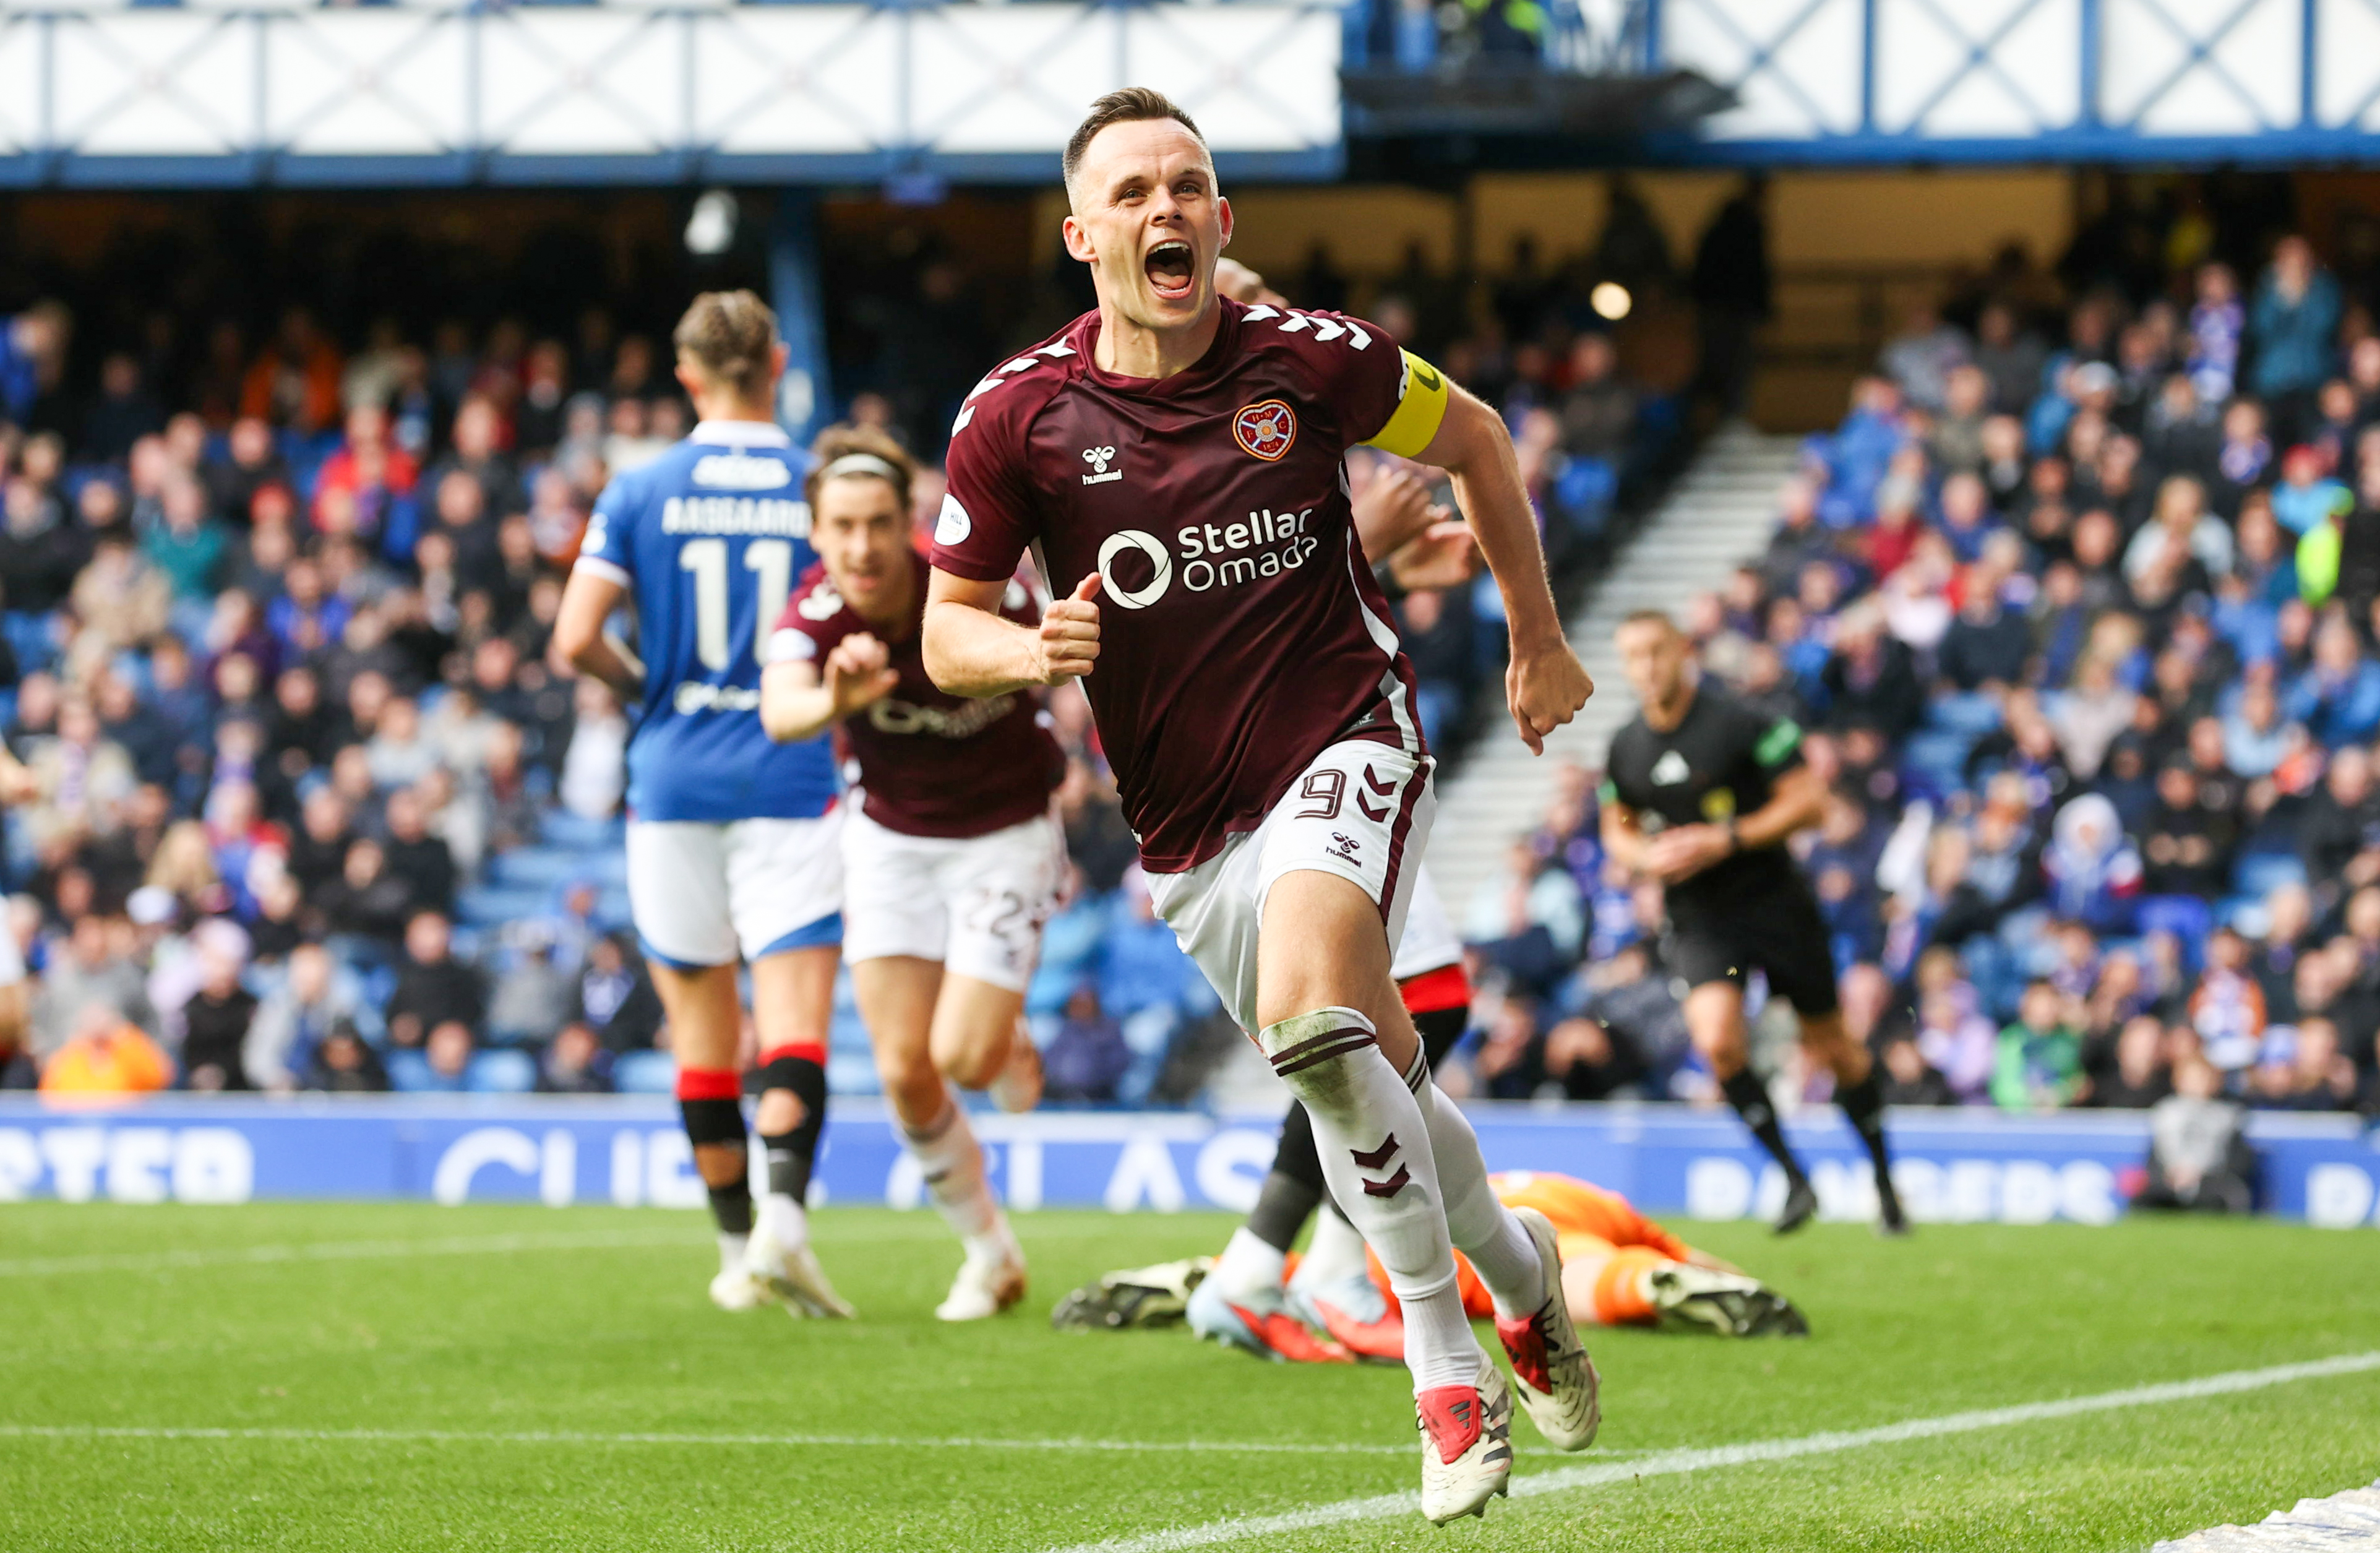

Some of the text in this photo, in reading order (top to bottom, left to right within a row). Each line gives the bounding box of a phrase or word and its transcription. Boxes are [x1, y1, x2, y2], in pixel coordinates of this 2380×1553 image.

[1082, 469, 1122, 485] hummel
[950, 511, 963, 526] HILL
[1178, 509, 1313, 559] Stellar
[679, 537, 793, 673] 11
[1294, 769, 1347, 820] 9
[1326, 846, 1362, 868] hummel
